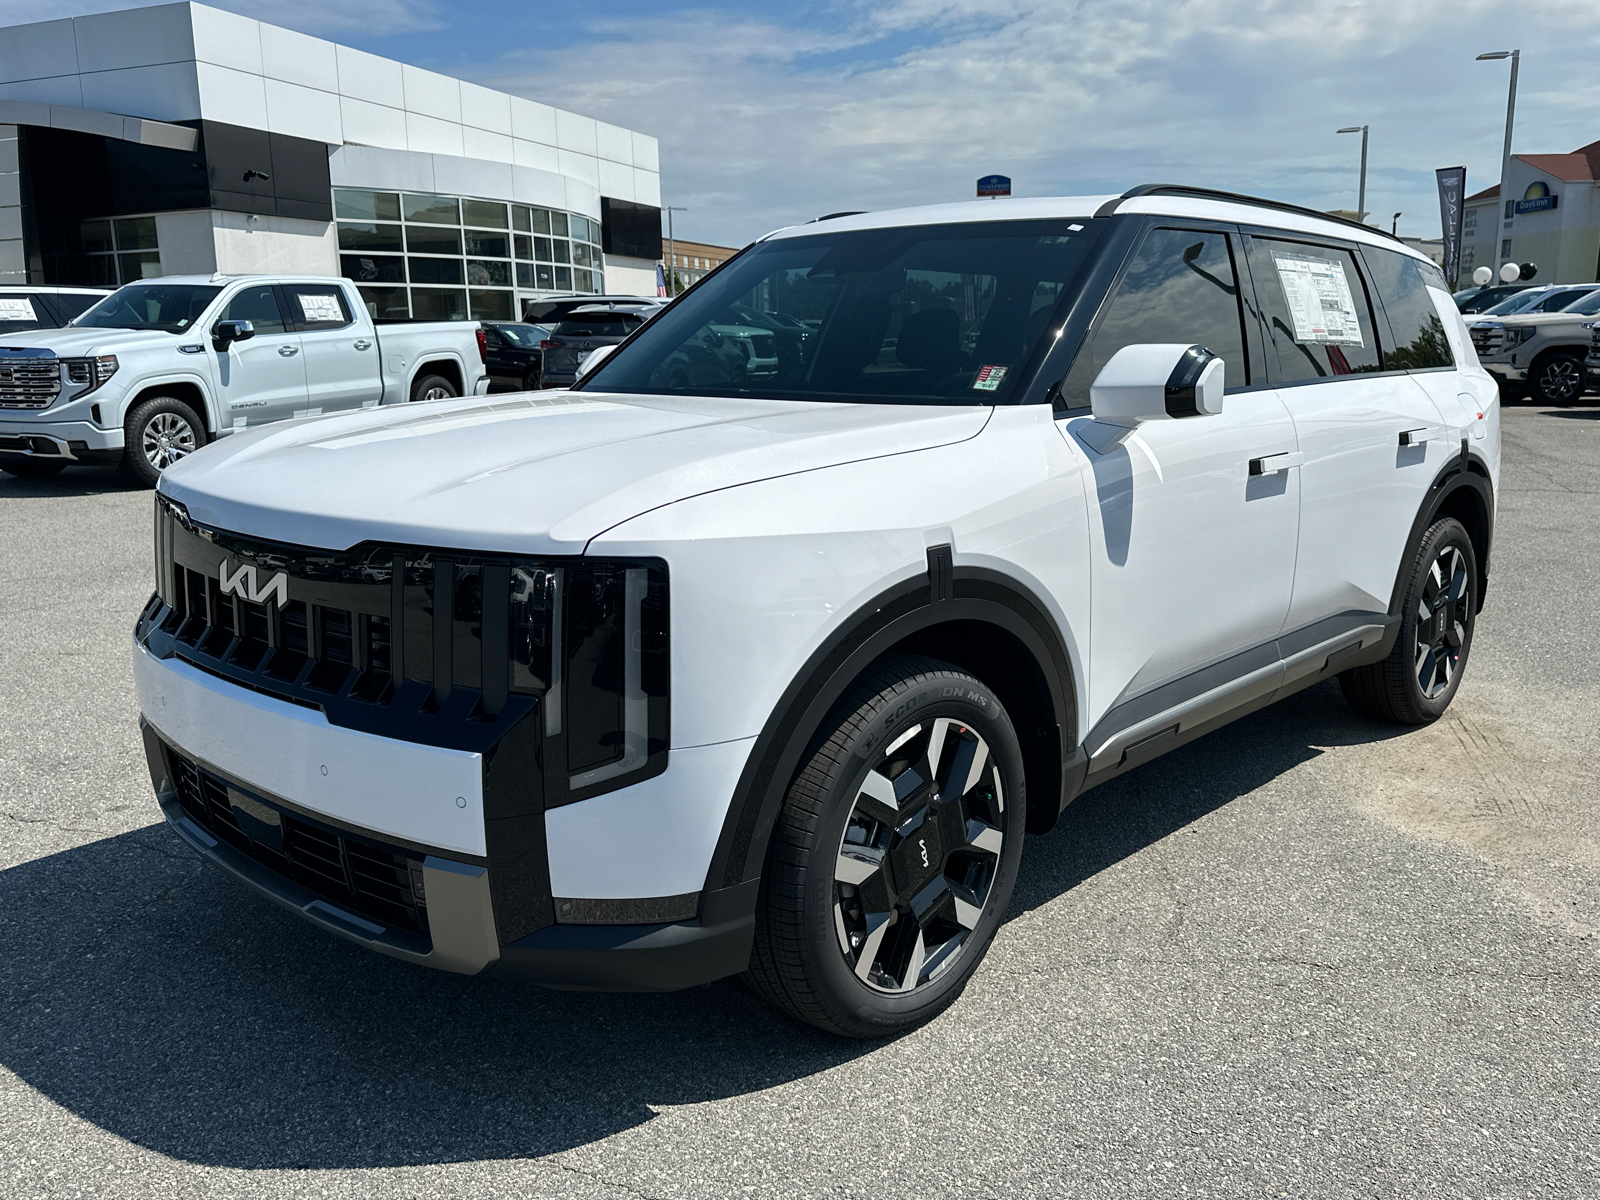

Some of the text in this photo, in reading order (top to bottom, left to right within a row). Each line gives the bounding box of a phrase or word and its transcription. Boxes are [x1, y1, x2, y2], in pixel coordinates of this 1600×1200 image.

[1520, 199, 1548, 209] Days Inn
[219, 558, 288, 610] KIA
[884, 686, 964, 729] SCORPION
[967, 690, 988, 706] MS
